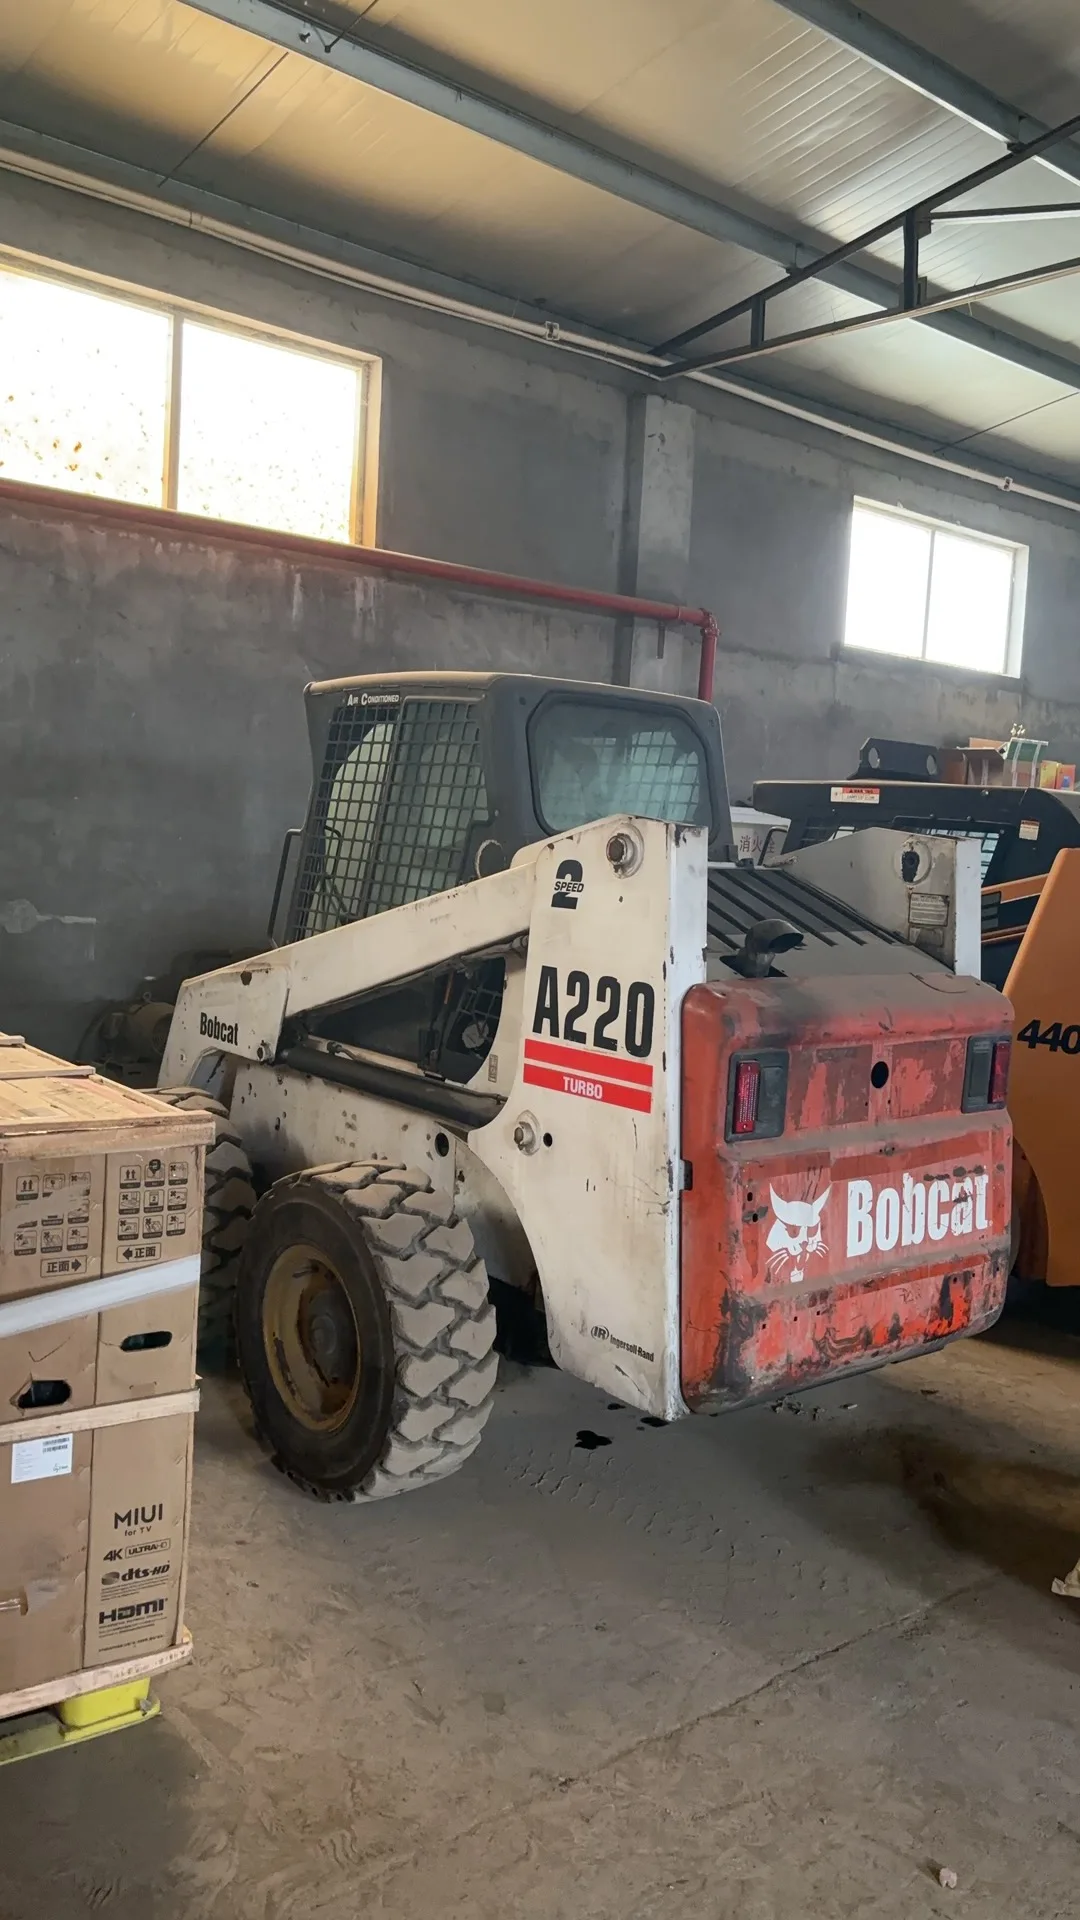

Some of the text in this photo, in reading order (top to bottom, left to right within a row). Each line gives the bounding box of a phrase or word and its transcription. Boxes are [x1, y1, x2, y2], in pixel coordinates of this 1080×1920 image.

[551, 859, 584, 910] 2
[554, 880, 585, 893] SPEED
[532, 965, 655, 1058] A220
[200, 1011, 239, 1046] Bobcat
[1017, 1019, 1080, 1055] 440
[563, 1075, 603, 1100] TURBO
[847, 1171, 990, 1258] Bobcat
[134, 1246, 156, 1259] 正面
[46, 1259, 70, 1273] 正面
[114, 1503, 163, 1530] MIUI
[124, 1525, 152, 1537] for TV
[103, 1549, 123, 1562] 4K
